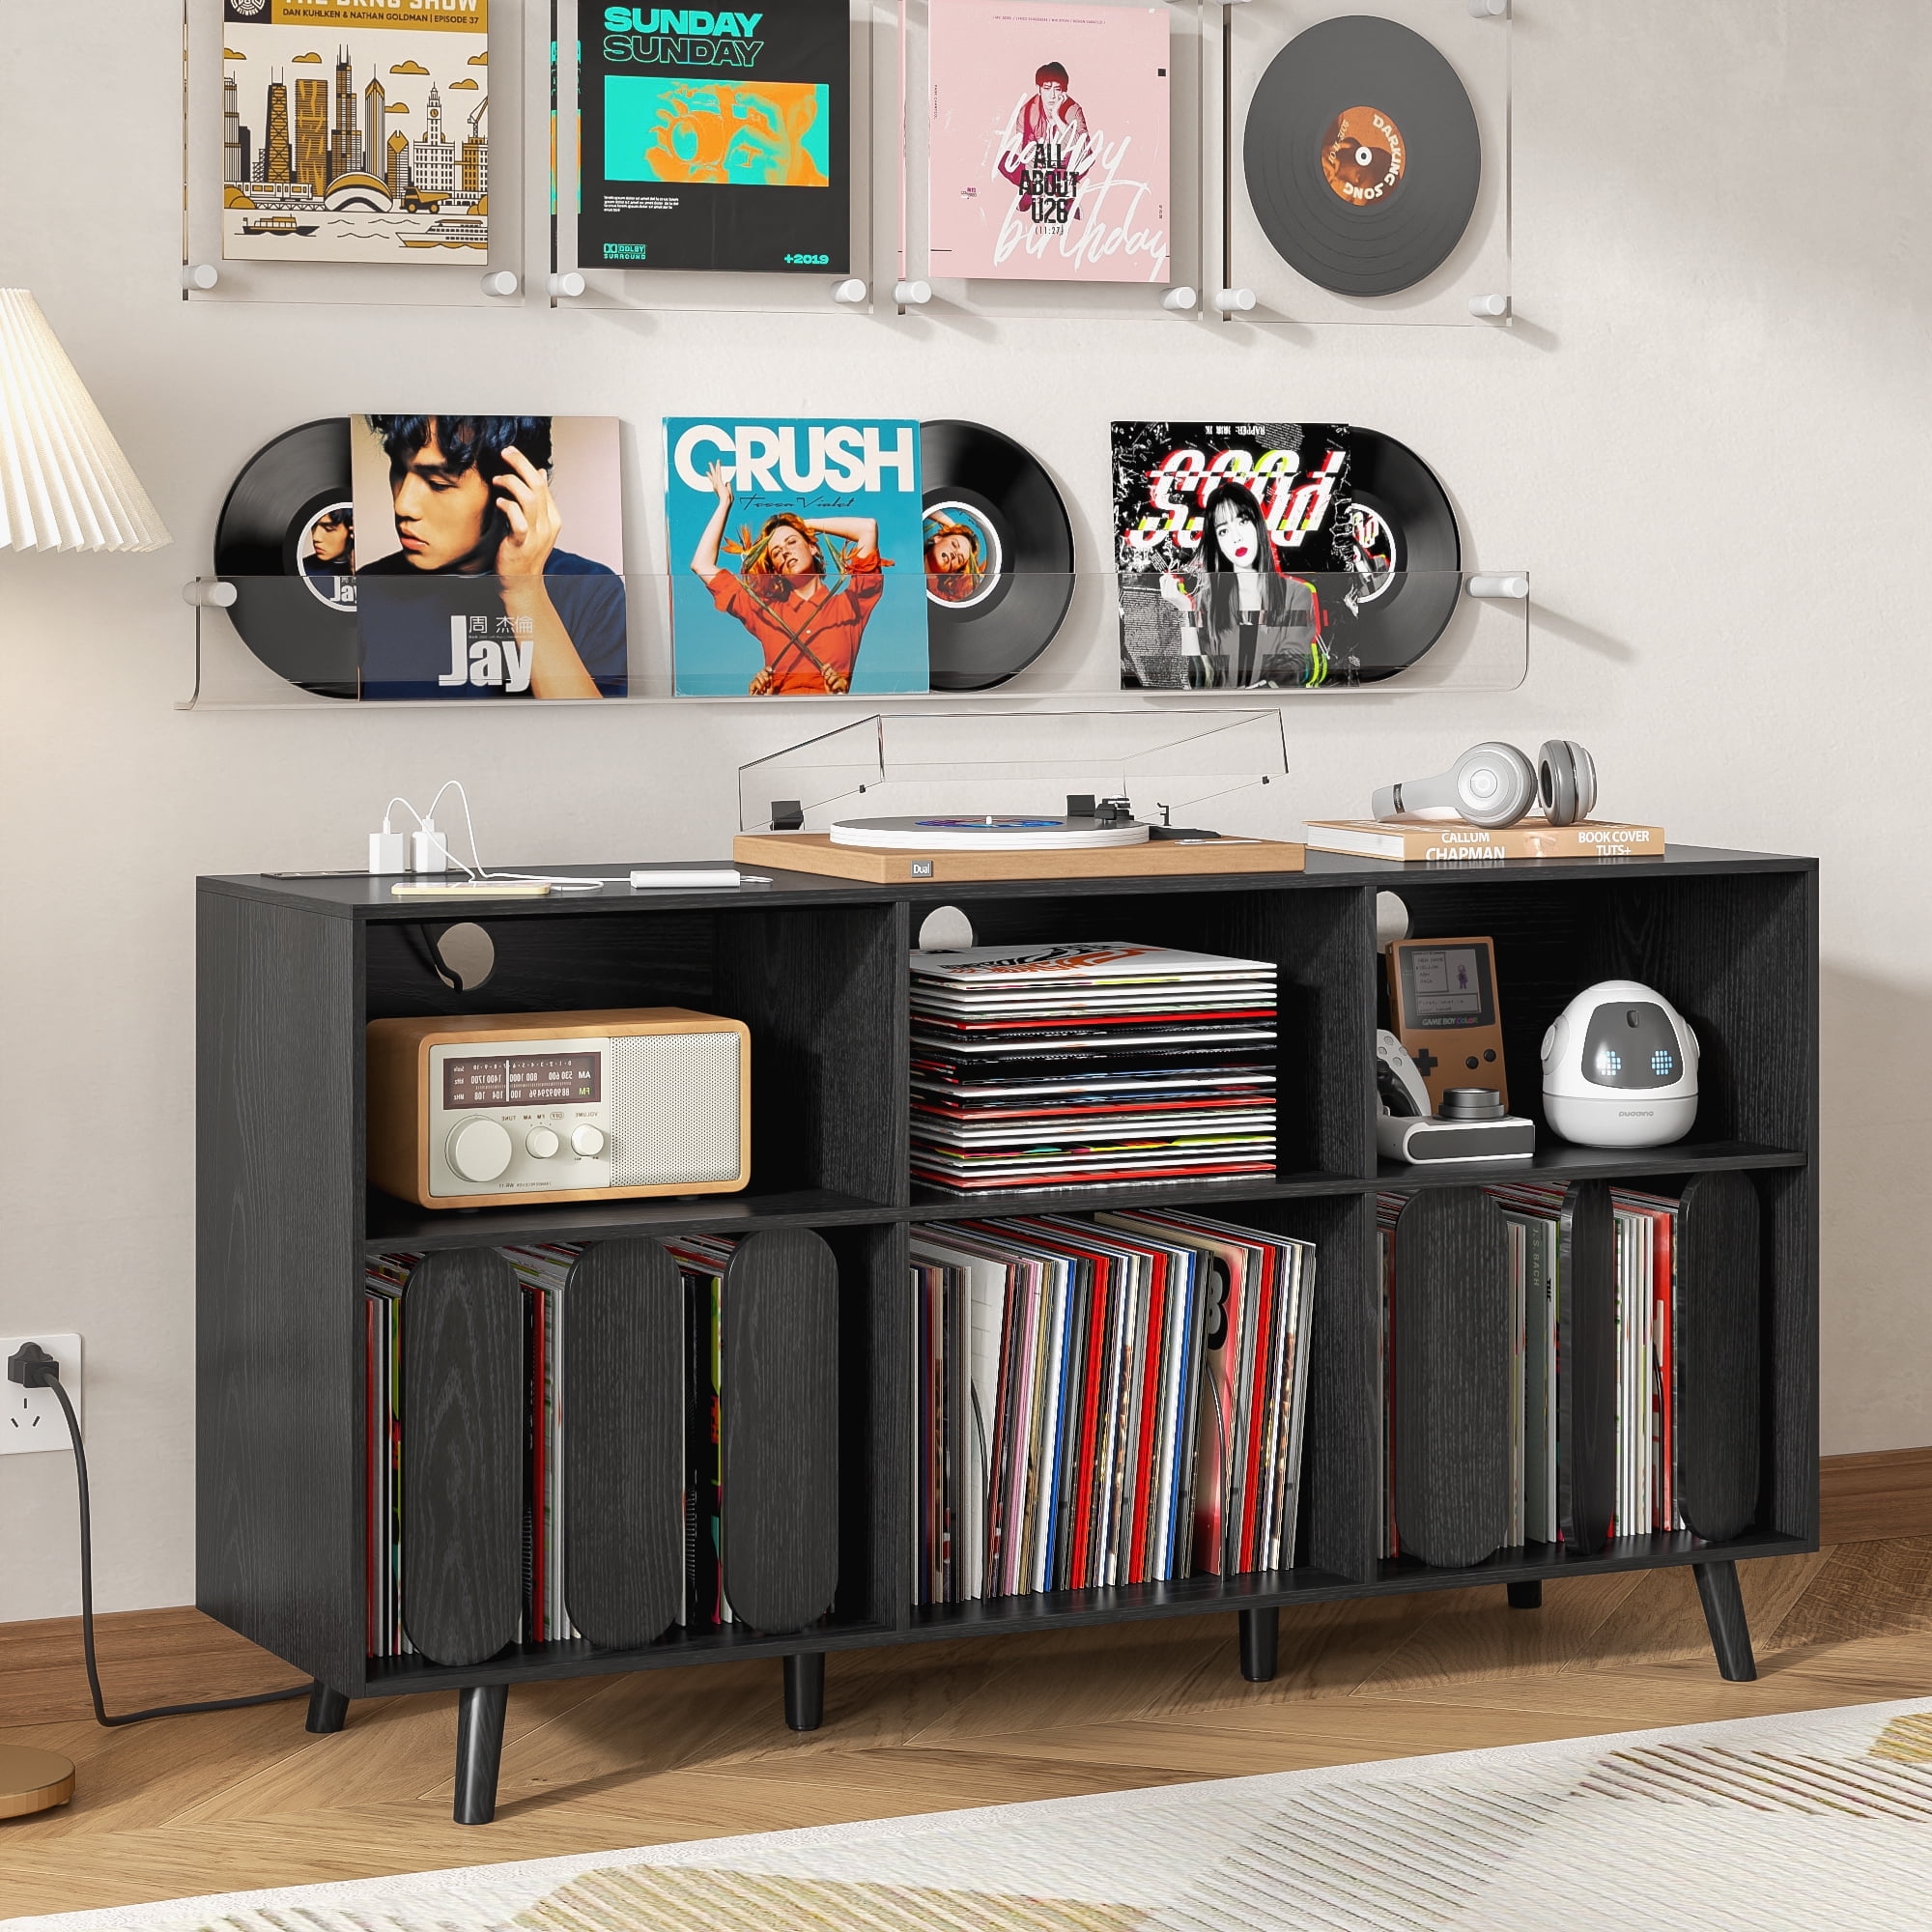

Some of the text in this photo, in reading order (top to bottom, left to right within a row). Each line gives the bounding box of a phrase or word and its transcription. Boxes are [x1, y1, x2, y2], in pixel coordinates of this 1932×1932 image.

[283, 8, 301, 16] DAN
[302, 9, 340, 18] KUHLKEN
[350, 12, 384, 20] NATHAN
[385, 13, 428, 22] GOLDMAN
[434, 14, 468, 24] EPISODE
[604, 6, 763, 38] SUNDAY
[603, 34, 764, 68] SUNDAY
[1034, 144, 1066, 169] ALL
[1019, 170, 1079, 198] ABOUT
[1343, 182, 1383, 200] SONG
[783, 253, 830, 265] +2019
[674, 424, 915, 494] CRUSH
[739, 494, 856, 511] Tessa Violet
[469, 615, 534, 634] 周 杰倫
[439, 615, 533, 693] Jay
[1441, 832, 1490, 843] CALLUM
[1578, 830, 1650, 843] BOOK COVER
[1425, 846, 1505, 861] CHAPMAN
[1596, 844, 1632, 856] TUTS+
[913, 863, 930, 874] Dual
